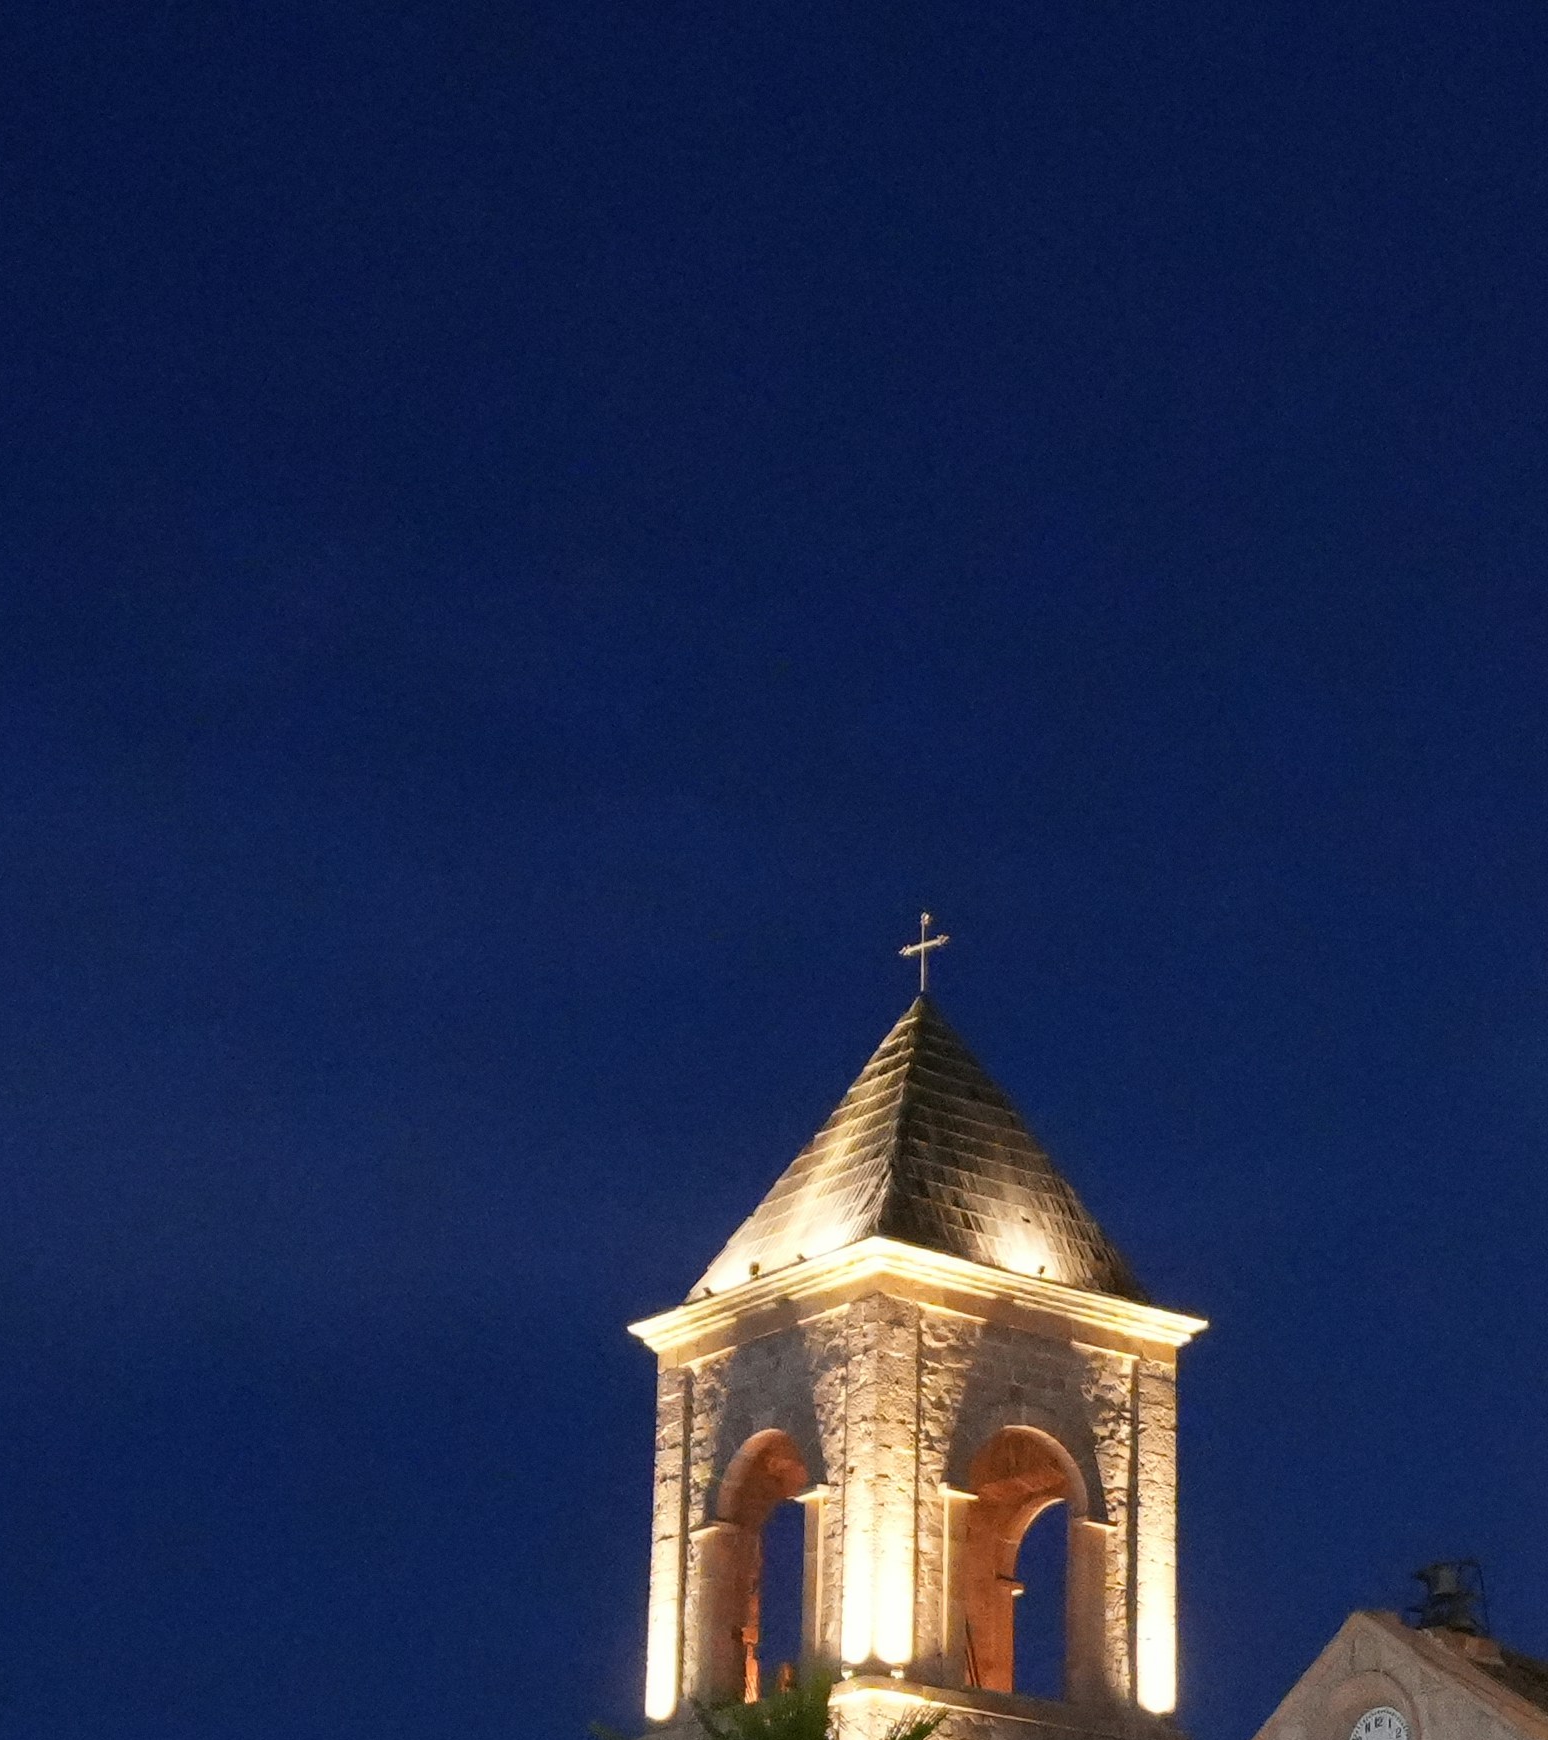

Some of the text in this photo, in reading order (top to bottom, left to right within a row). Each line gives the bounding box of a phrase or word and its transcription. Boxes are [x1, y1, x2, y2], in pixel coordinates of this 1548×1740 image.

[1365, 1721, 1371, 1733] 11
[1374, 1716, 1383, 1728] 12
[1388, 1717, 1392, 1728] 1
[1395, 1727, 1402, 1738] 2
